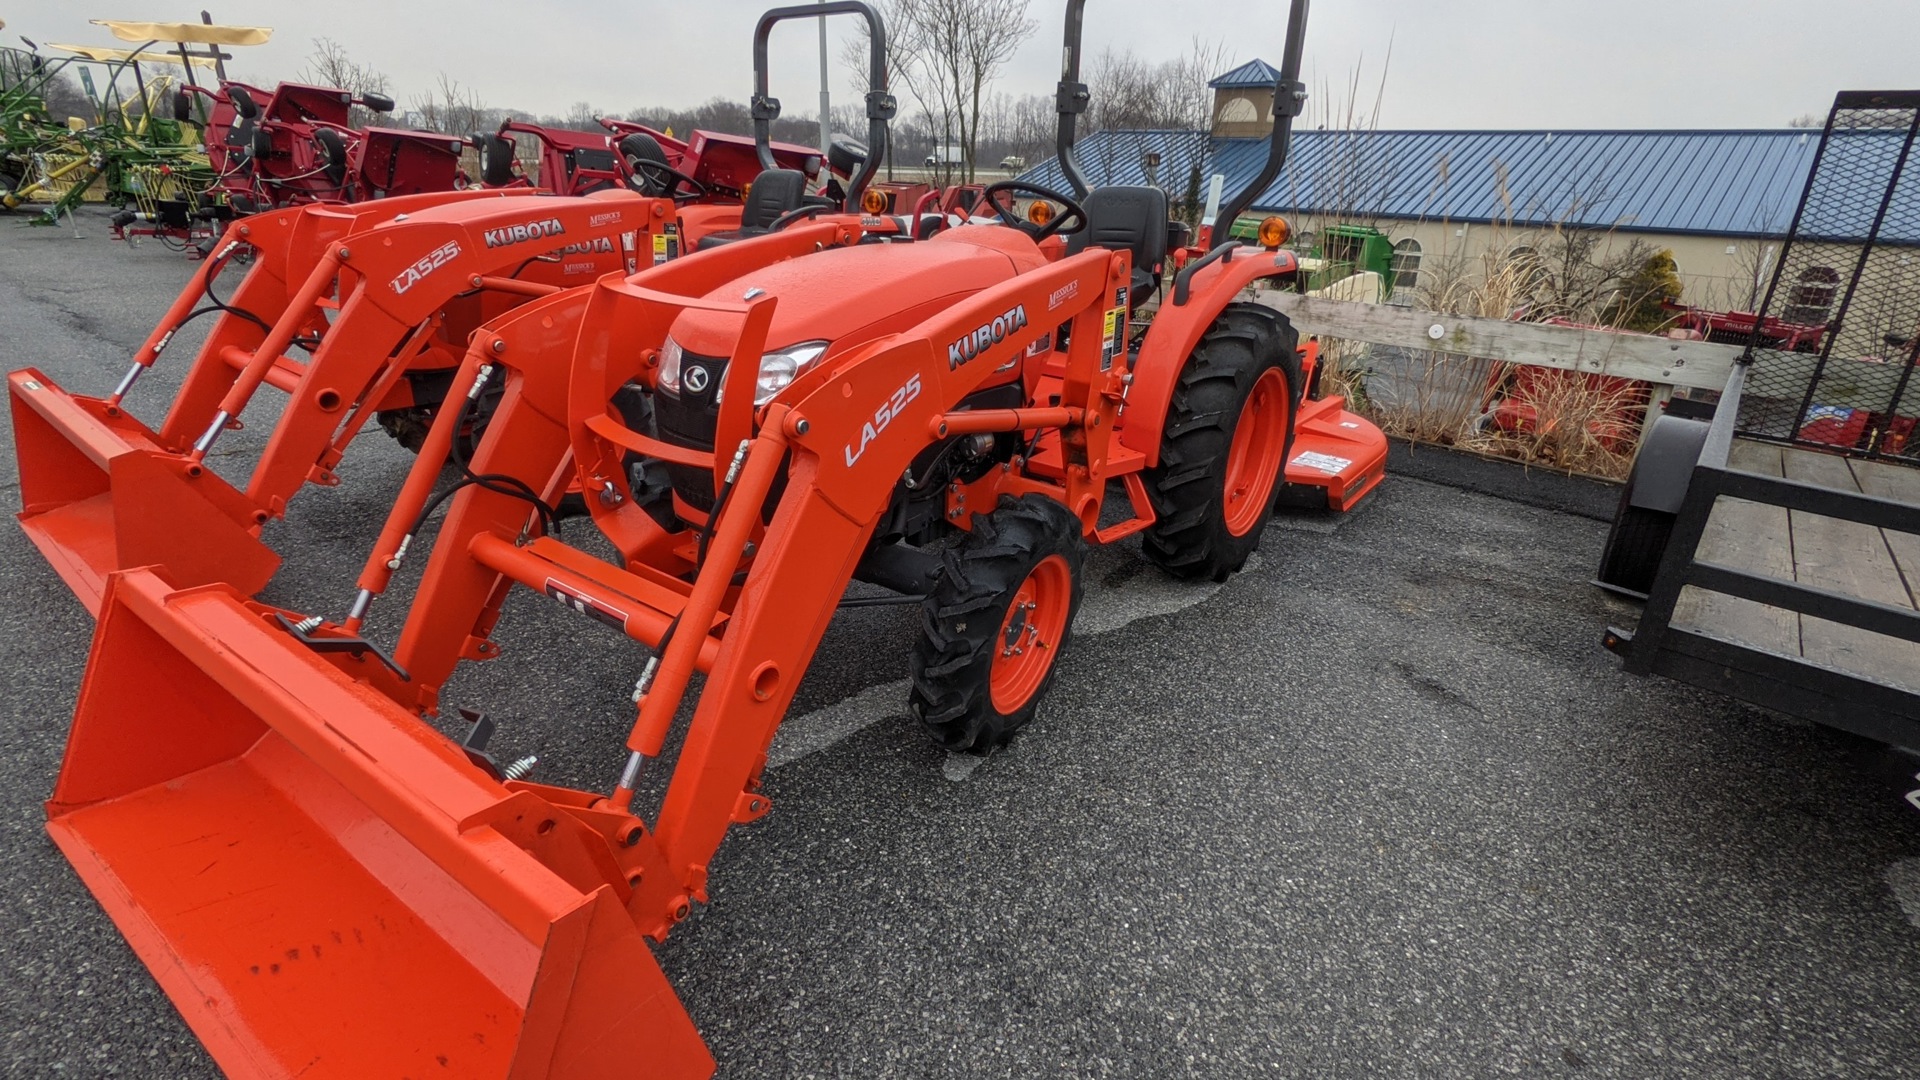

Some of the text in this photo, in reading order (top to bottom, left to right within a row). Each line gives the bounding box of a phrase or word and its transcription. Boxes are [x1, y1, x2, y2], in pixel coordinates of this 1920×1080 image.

[484, 219, 565, 248] KUBOTA
[564, 236, 615, 254] BOTA
[391, 240, 460, 295] LA525
[948, 303, 1028, 372] KUBOTA
[1724, 322, 1754, 332] MILLER
[844, 372, 922, 468] LA525
